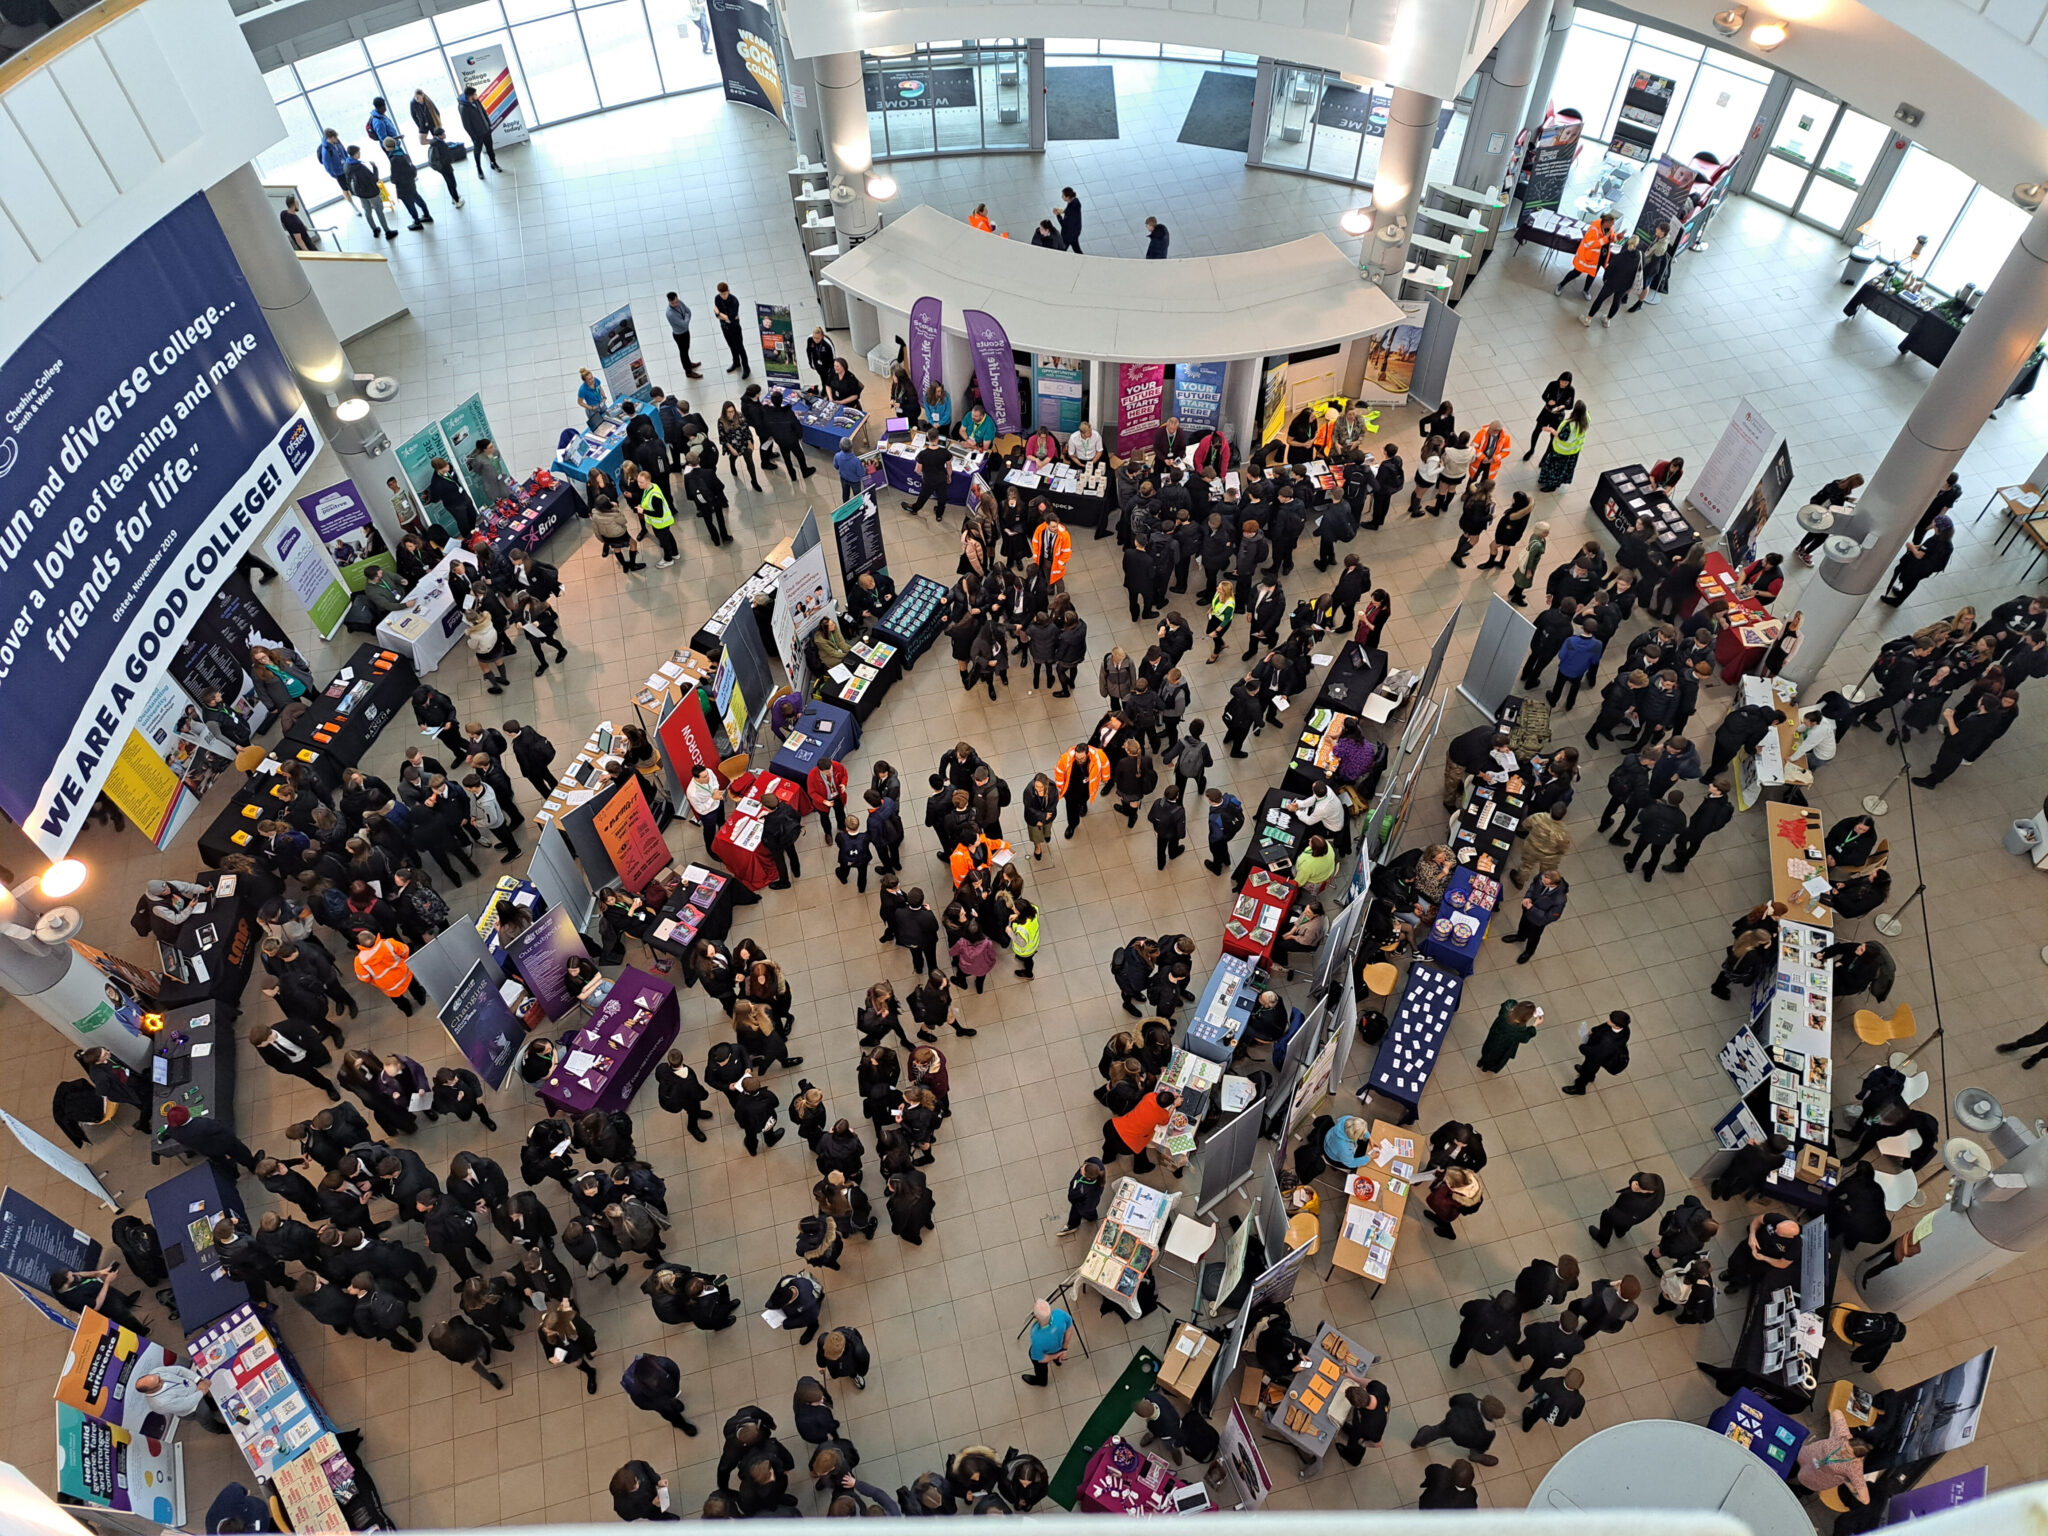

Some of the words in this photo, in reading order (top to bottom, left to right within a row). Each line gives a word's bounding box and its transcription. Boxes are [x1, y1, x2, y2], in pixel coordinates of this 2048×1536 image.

[736, 41, 778, 76] GOOD
[464, 73, 487, 82] College
[745, 61, 778, 88] COLLEGE
[876, 97, 949, 109] WELCOME
[209, 333, 257, 386] make
[5, 387, 38, 424] Cheshire
[35, 359, 64, 390] College
[174, 374, 211, 420] and
[1123, 389, 1161, 405] FUTURE
[1127, 381, 1157, 395] YOUR
[1177, 392, 1218, 400] FUTURE
[1181, 383, 1214, 393] YOUR
[13, 408, 34, 434] South
[35, 386, 55, 407] West
[29, 466, 66, 519] and
[60, 365, 152, 474] diverse
[149, 300, 236, 376] College...
[1126, 398, 1159, 410] STARTS
[1129, 406, 1154, 418] HERE
[1180, 400, 1216, 409] STARTS
[1183, 407, 1209, 416] HERE
[285, 427, 308, 456] Ofsted
[100, 414, 177, 499] learning
[86, 488, 107, 523] of
[538, 513, 557, 535] Brio
[33, 516, 89, 589] love
[132, 552, 163, 592] November
[161, 529, 178, 553] 2019
[46, 548, 121, 663] friends
[115, 500, 152, 555] for
[29, 589, 46, 609] a
[41, 770, 85, 838] WE
[80, 703, 122, 783] ARE
[111, 682, 135, 719] A
[125, 588, 188, 684] GOOD
[185, 463, 282, 591] COLLEGE!
[518, 947, 533, 959] Our
[450, 980, 487, 1029] Changing
[87, 1357, 101, 1383] Make
[92, 1336, 117, 1398] difference
[83, 1425, 91, 1456] build
[90, 1422, 98, 1449] fairer
[97, 1428, 106, 1469] stronger
[83, 1457, 92, 1484] Help
[104, 1430, 112, 1494] communities
[98, 1470, 106, 1492] and
